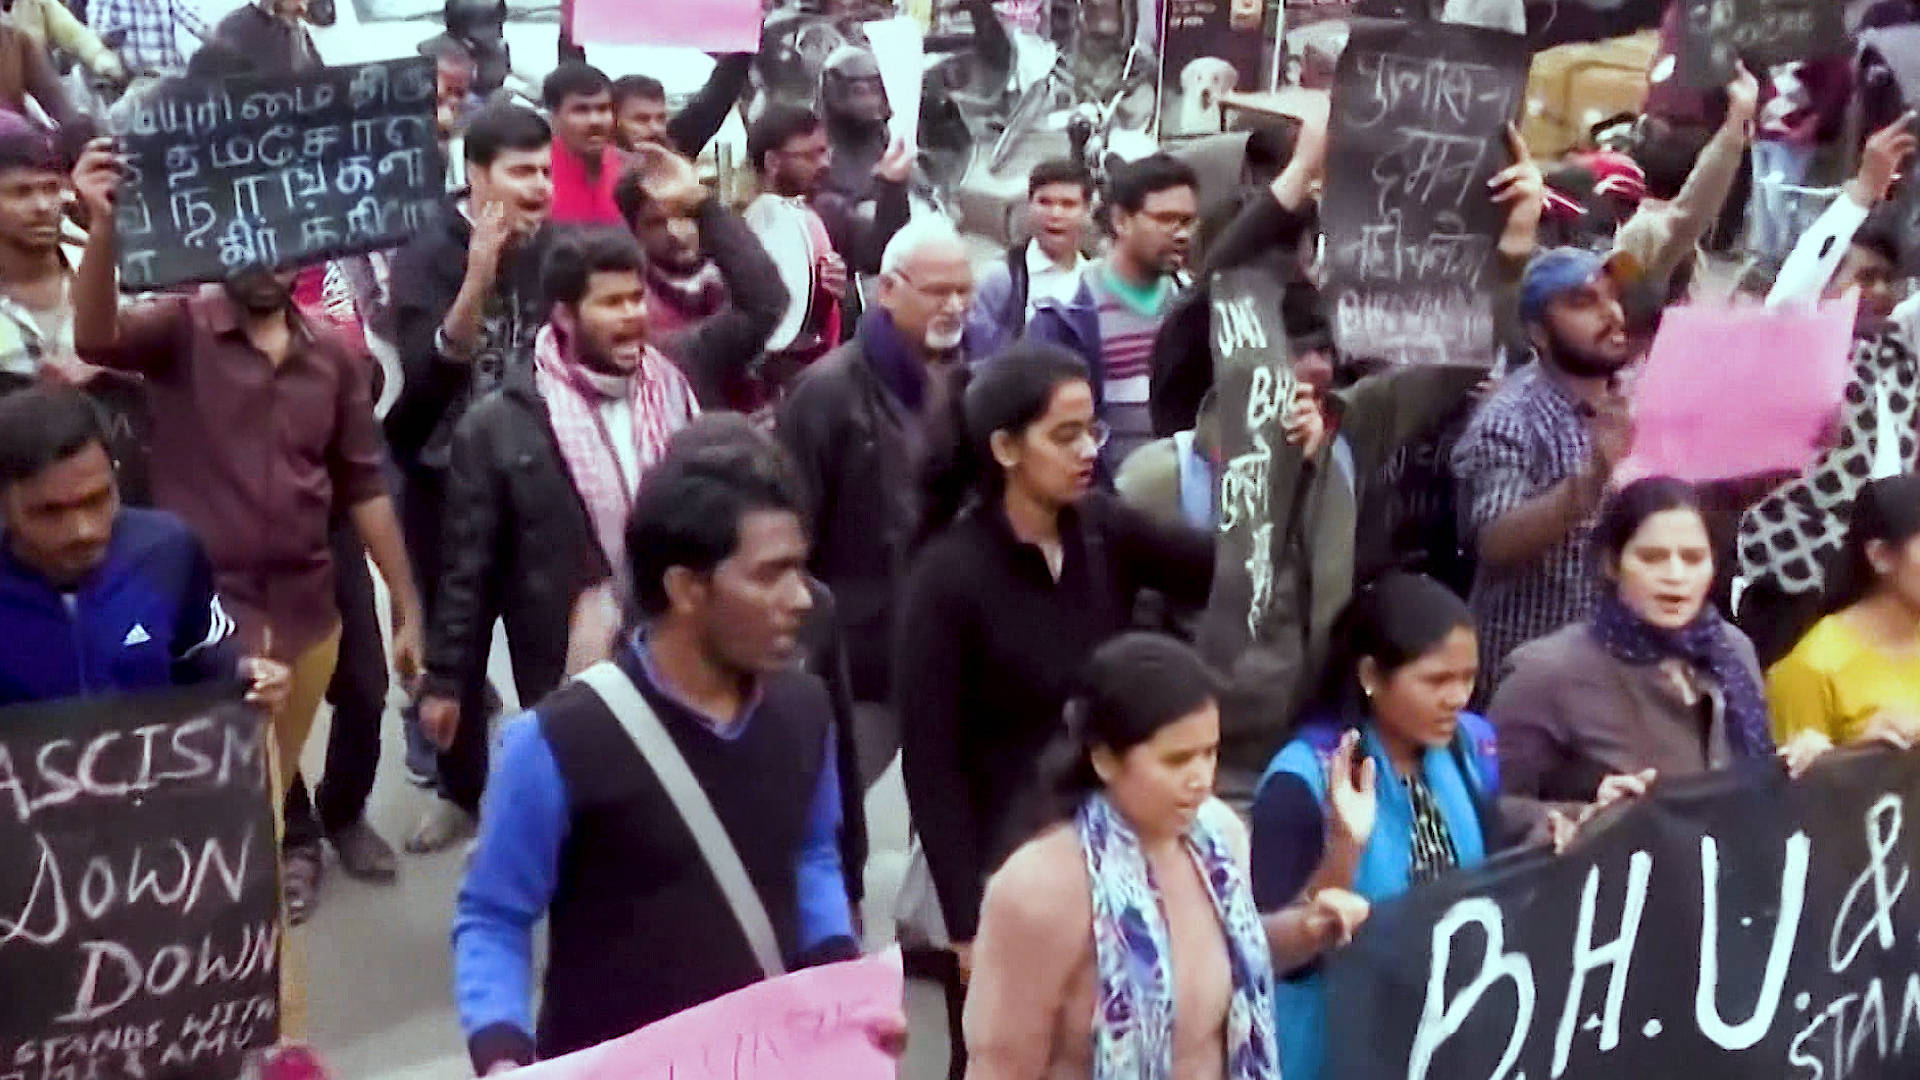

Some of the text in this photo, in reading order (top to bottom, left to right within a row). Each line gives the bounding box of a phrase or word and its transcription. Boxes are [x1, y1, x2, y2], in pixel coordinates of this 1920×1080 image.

[0, 830, 252, 944] DOWN
[1830, 793, 1910, 973] &
[54, 924, 278, 1024] DOWN
